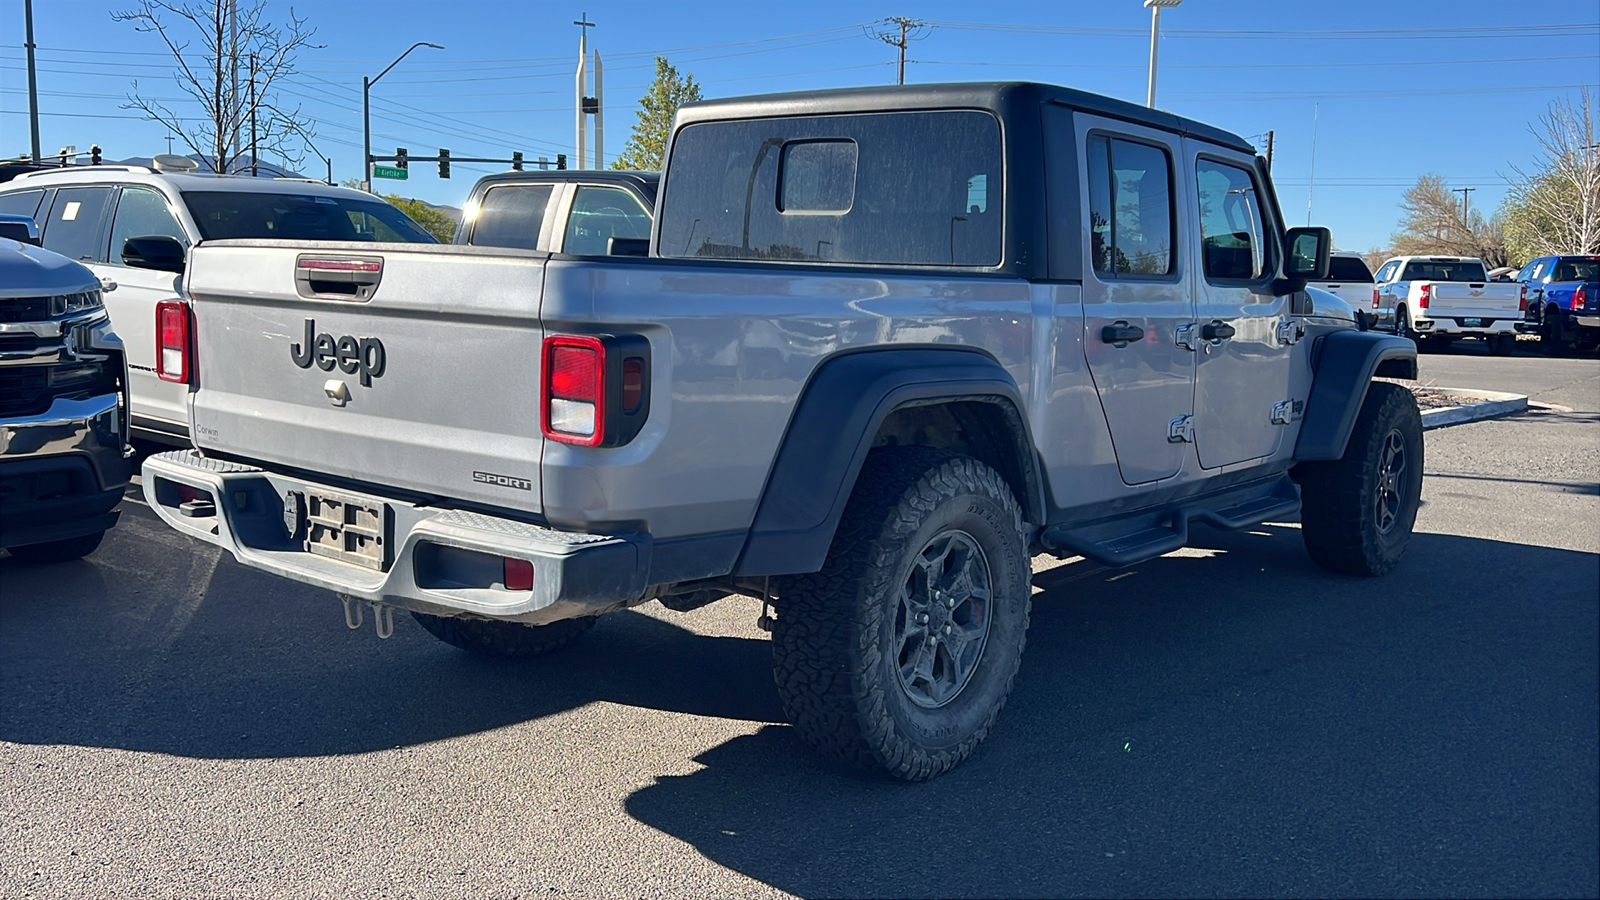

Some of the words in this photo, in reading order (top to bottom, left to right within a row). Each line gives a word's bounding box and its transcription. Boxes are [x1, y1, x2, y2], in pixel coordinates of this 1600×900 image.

[381, 169, 399, 177] Kietzke
[290, 317, 386, 388] Jeep
[196, 423, 219, 437] Corwin
[473, 472, 532, 489] SPORT
